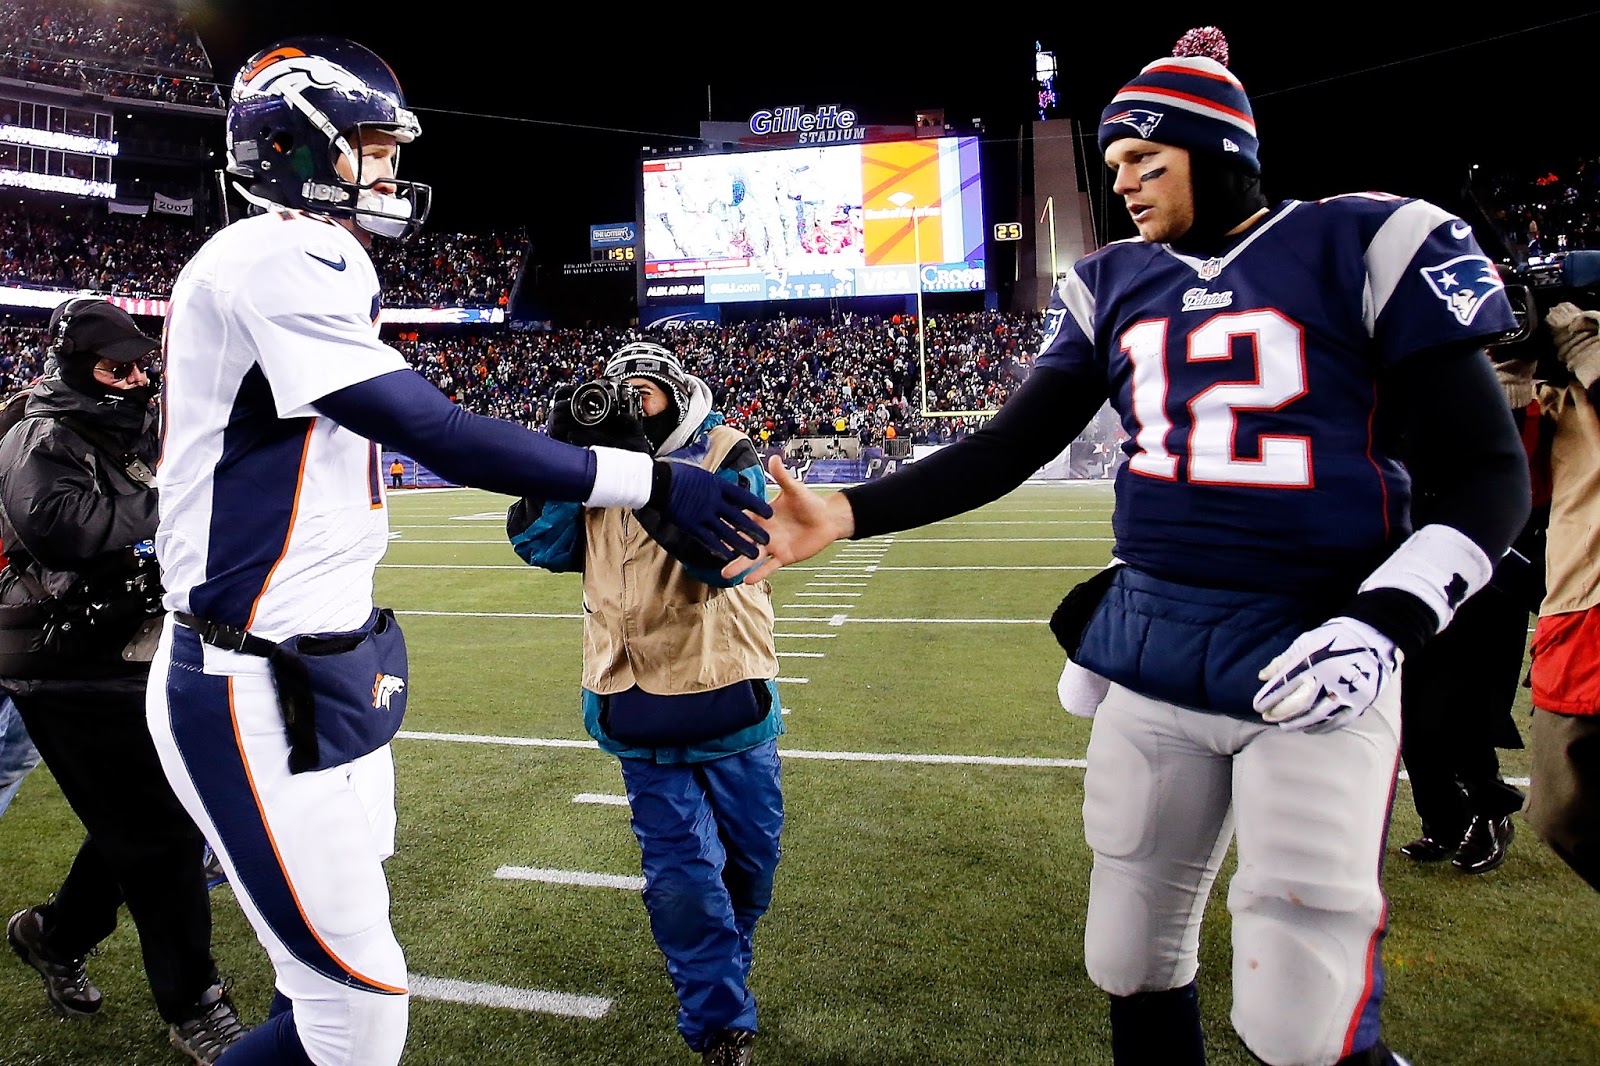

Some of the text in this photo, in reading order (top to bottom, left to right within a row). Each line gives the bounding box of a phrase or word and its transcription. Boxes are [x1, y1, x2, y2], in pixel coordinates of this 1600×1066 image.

[750, 106, 855, 135] Gillette
[799, 128, 865, 143] STADIUM
[159, 202, 188, 212] 2007
[998, 225, 1018, 238] 25
[1182, 288, 1233, 312] Patriots
[1119, 307, 1315, 489] 12
